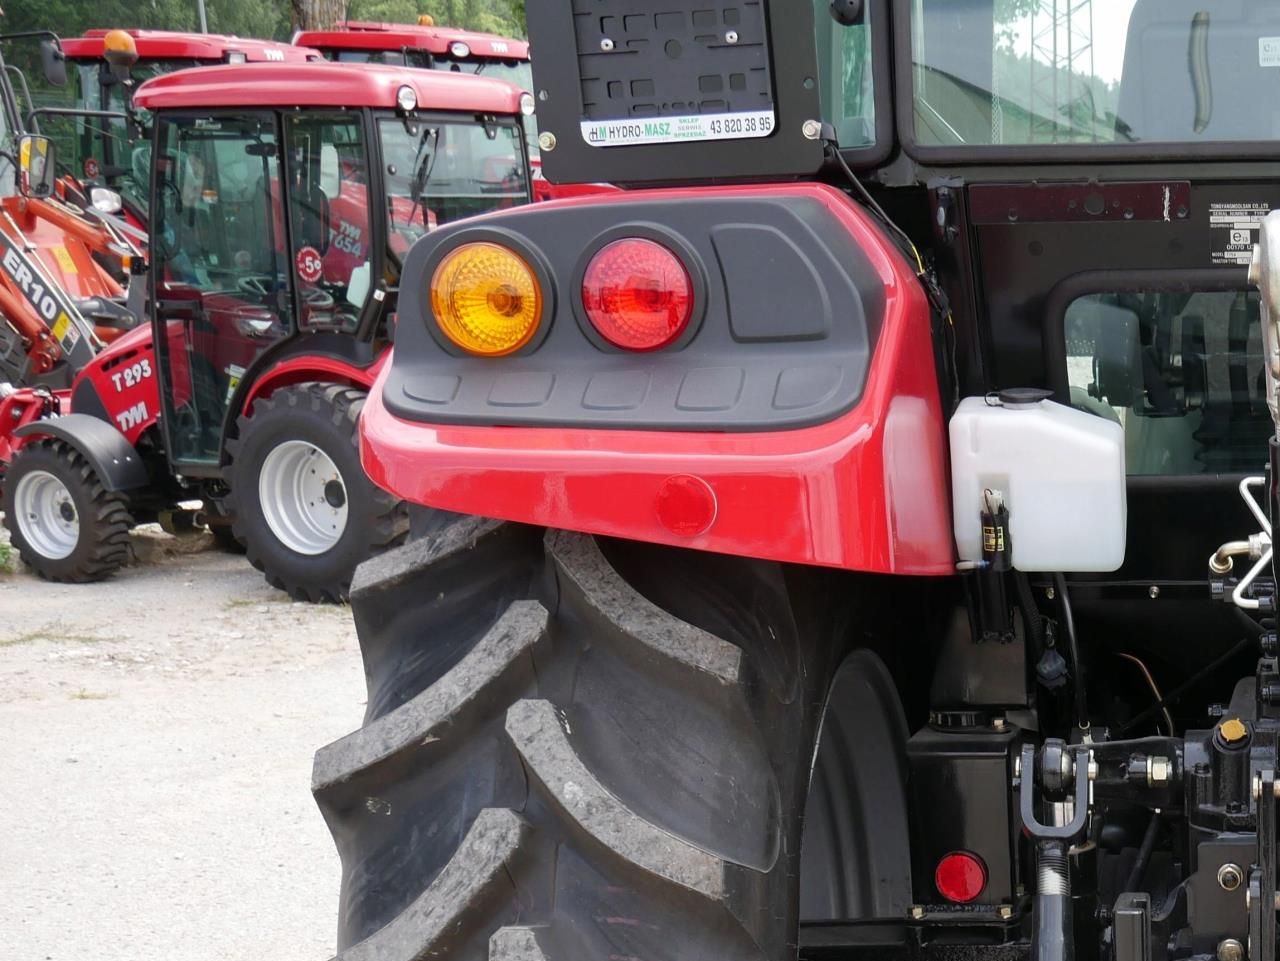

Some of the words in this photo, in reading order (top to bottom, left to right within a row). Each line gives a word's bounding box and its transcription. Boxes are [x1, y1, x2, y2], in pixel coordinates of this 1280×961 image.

[710, 120, 722, 134] 43
[724, 119, 742, 133] 820
[745, 118, 757, 131] 38
[760, 117, 771, 130] 95
[3, 248, 57, 320] ER10
[116, 401, 148, 432] TYM
